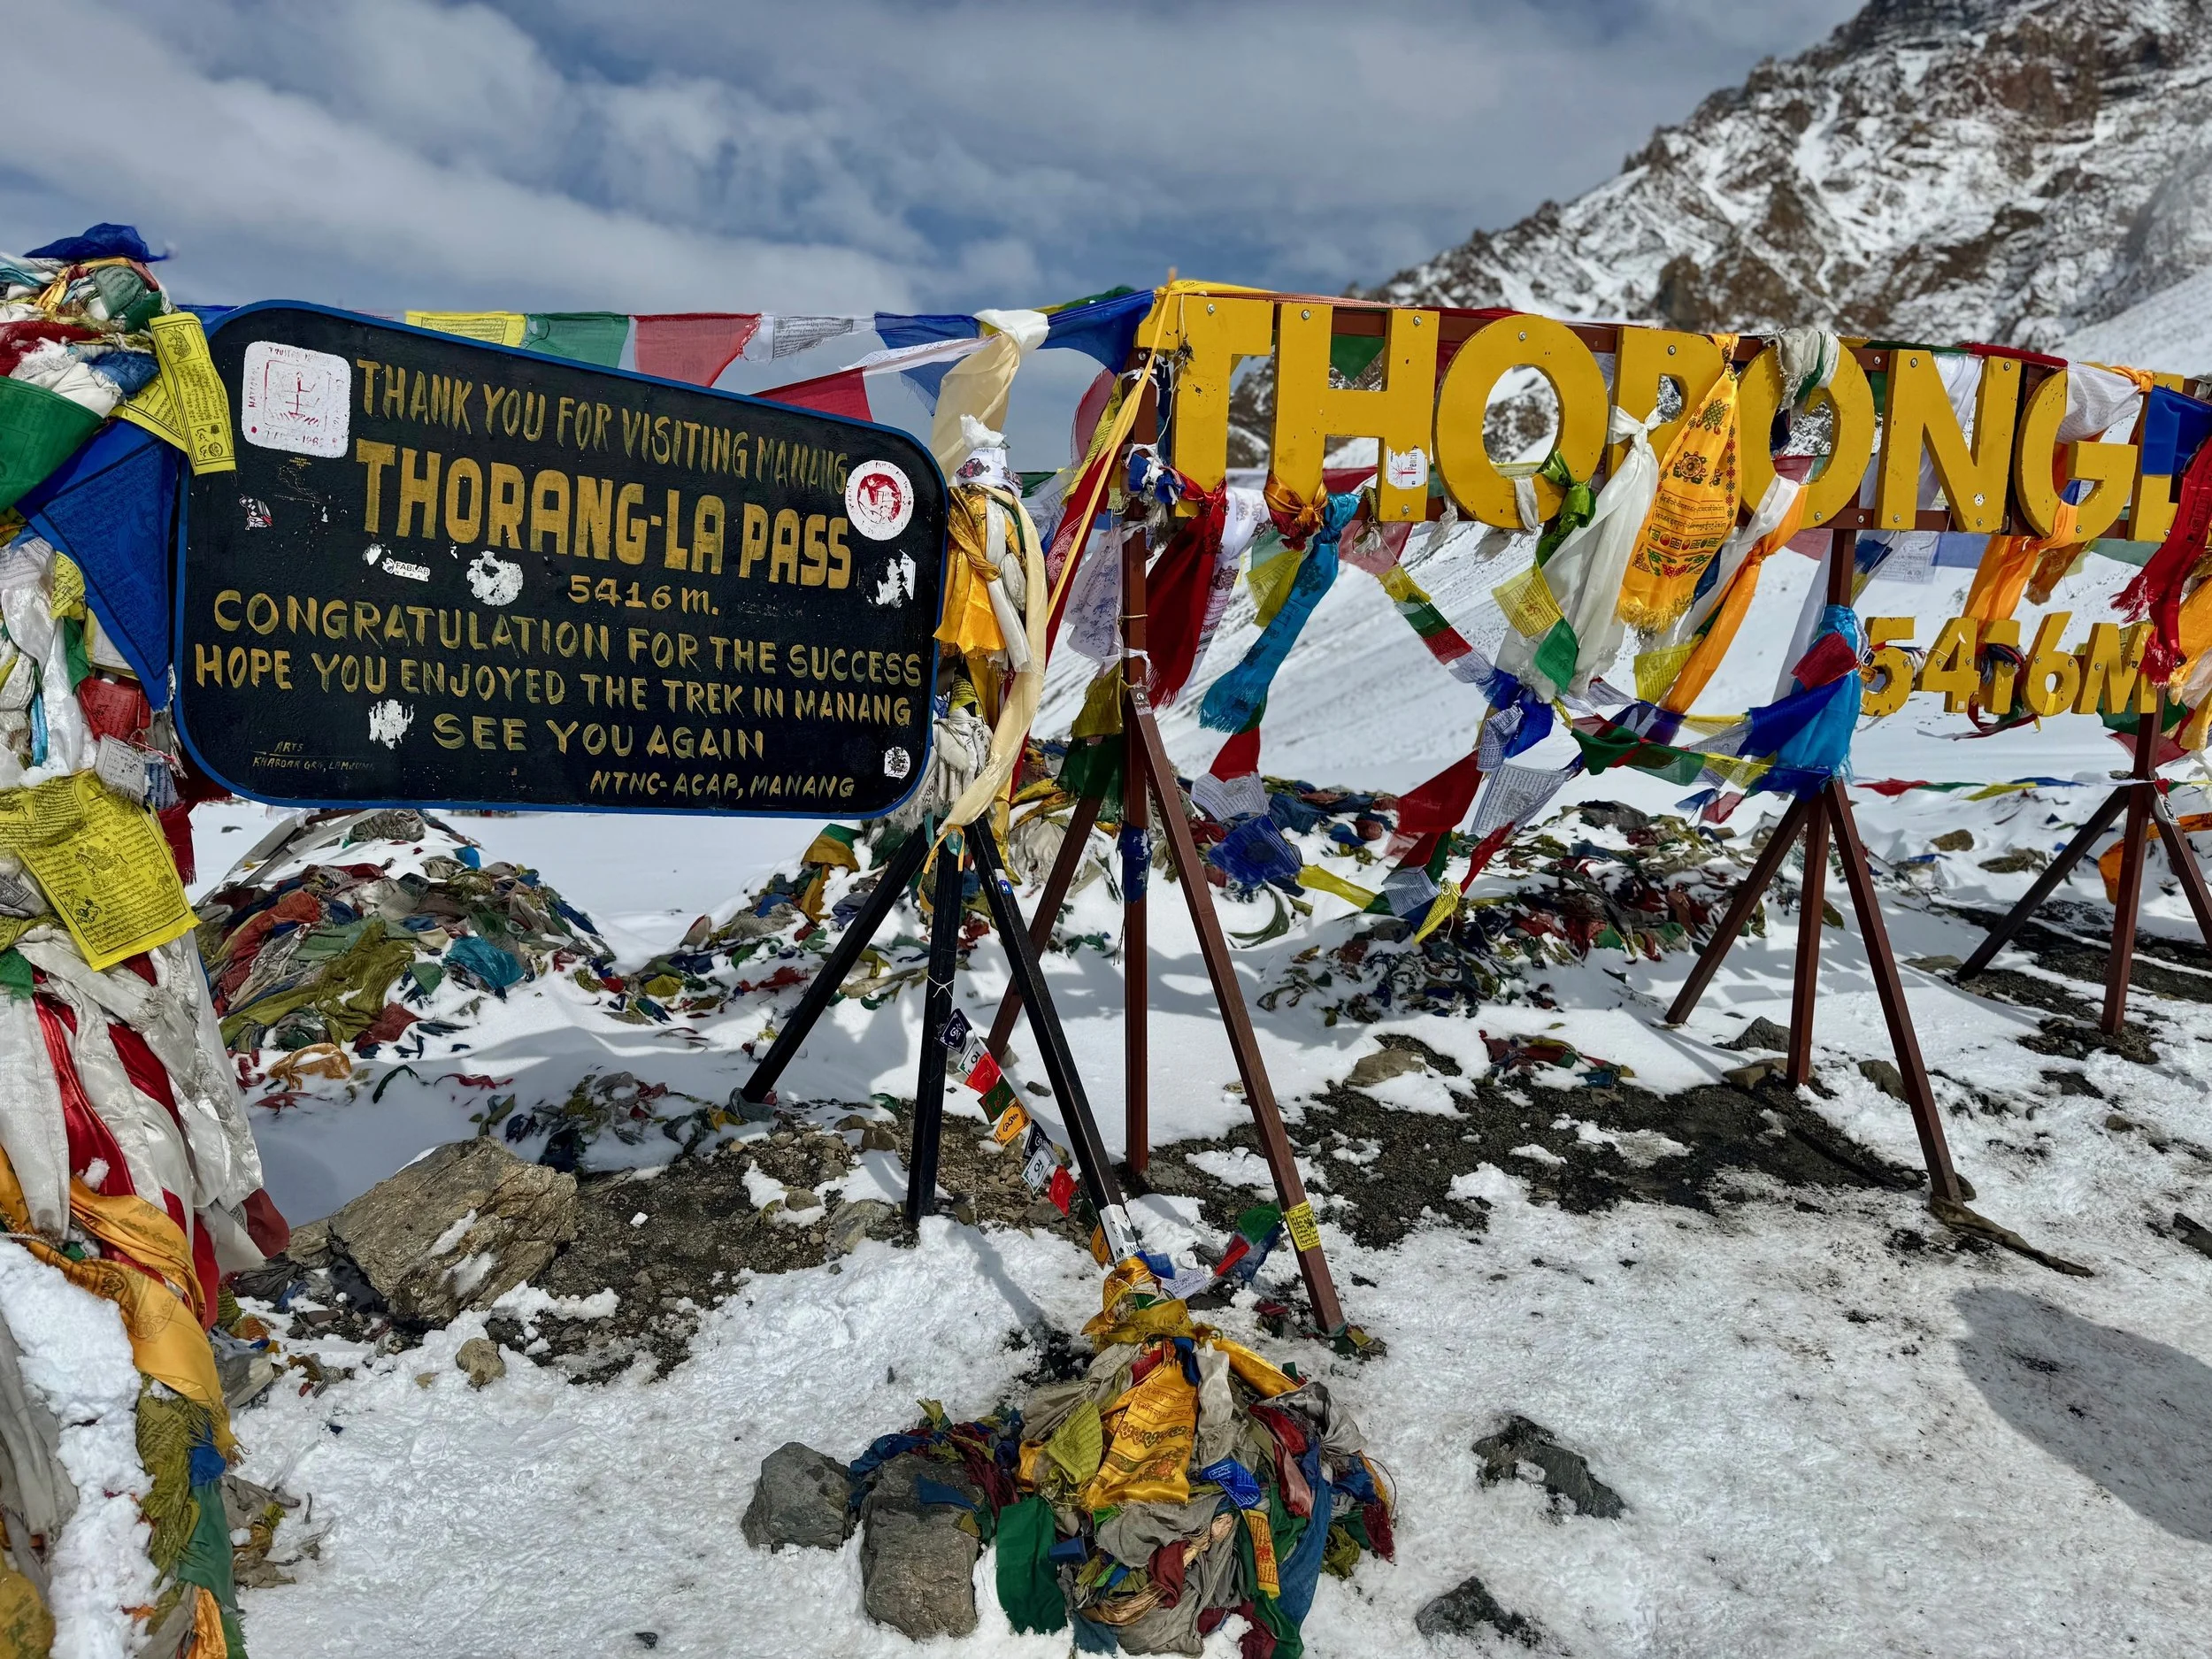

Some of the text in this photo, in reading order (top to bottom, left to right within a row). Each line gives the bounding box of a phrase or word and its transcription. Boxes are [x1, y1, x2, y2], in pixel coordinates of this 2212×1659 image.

[357, 358, 472, 434] THANK
[483, 383, 546, 441] YOU
[557, 396, 613, 452] FOR
[622, 408, 749, 479] VISITING
[356, 439, 726, 575] THORANG-LA
[739, 503, 851, 589] PASS
[567, 575, 672, 611] 5416
[214, 589, 922, 687] CONGRATULATION FOR THE SUCCESS
[196, 643, 911, 728] HOPE YOU ENJOYED THE TREK IN MANANG
[432, 713, 764, 761] SEE YOU AGAIN
[750, 775, 856, 799] MANANG
